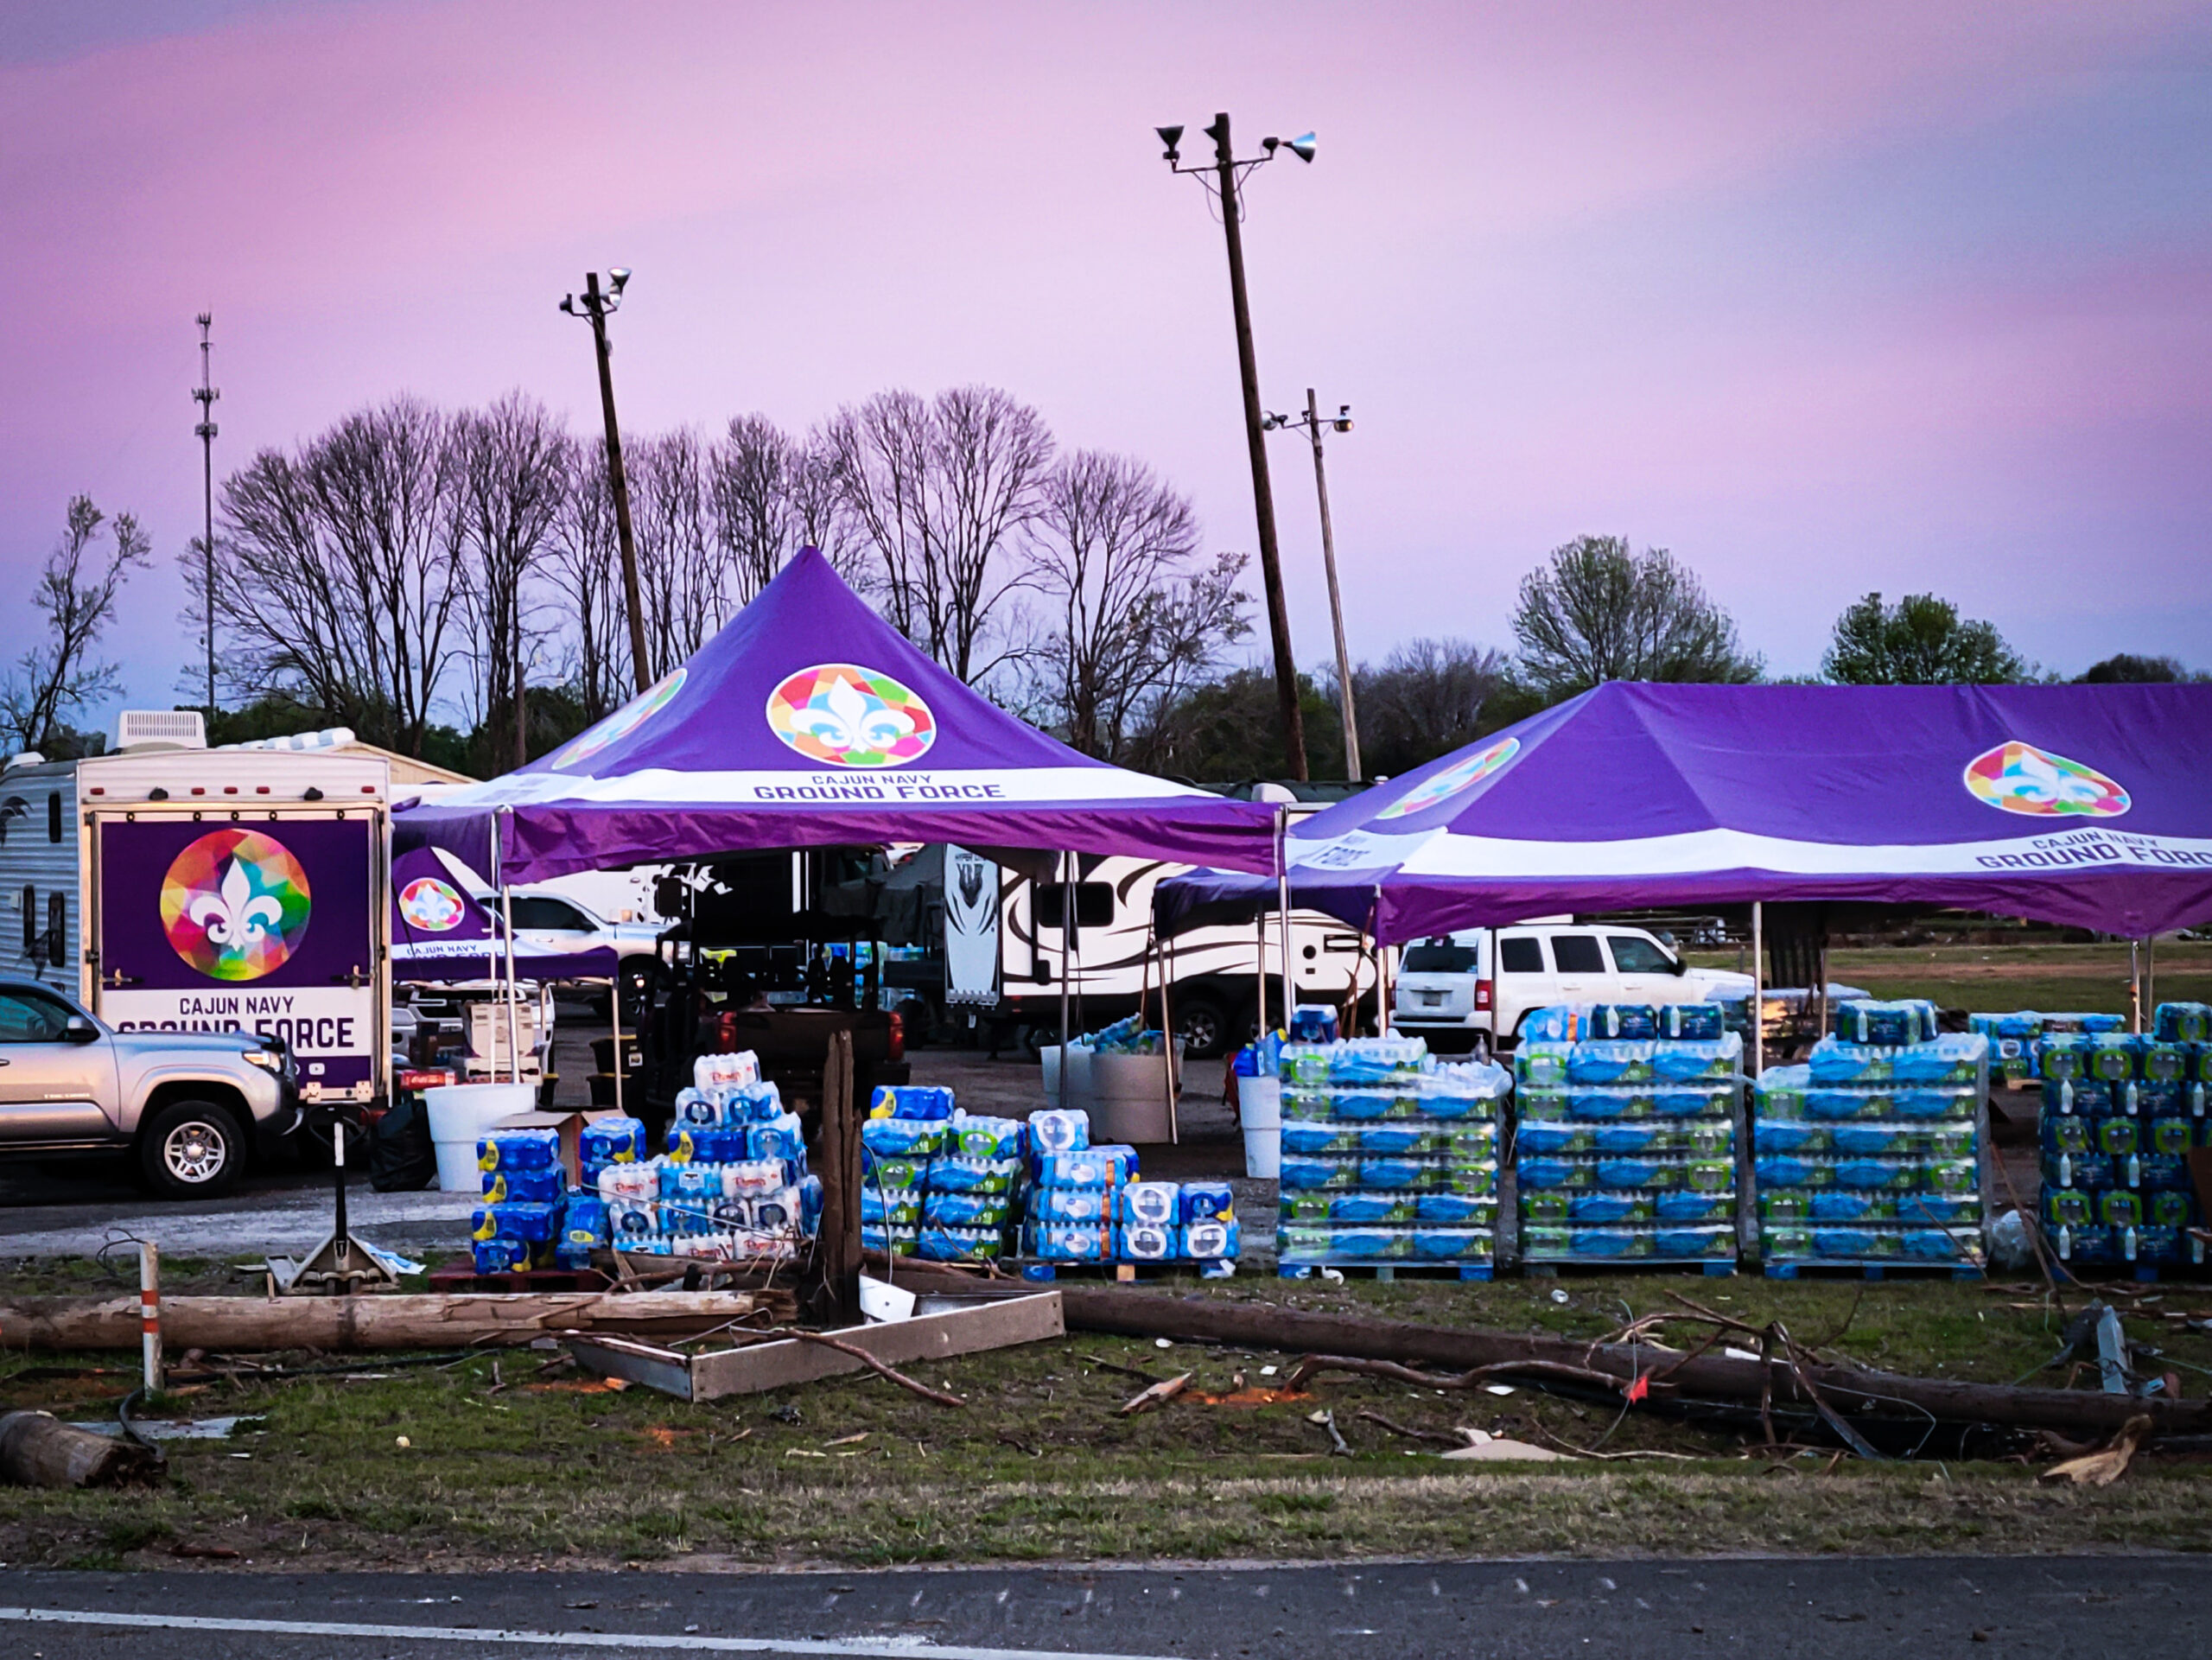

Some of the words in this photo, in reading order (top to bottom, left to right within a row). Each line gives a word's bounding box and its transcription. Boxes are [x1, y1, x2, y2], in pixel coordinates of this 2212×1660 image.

[811, 775, 874, 785] CAJUN
[880, 774, 931, 785] NAVY
[753, 785, 885, 799] GROUND
[893, 785, 1006, 798] FORCE
[2031, 831, 2101, 849] CAJUN
[2106, 833, 2158, 848] NAVY
[1975, 843, 2122, 868] GROUND
[447, 944, 477, 952] NAVY
[179, 997, 239, 1014] CAJUN
[245, 995, 295, 1014] NAVY
[255, 1017, 355, 1048] FORCE
